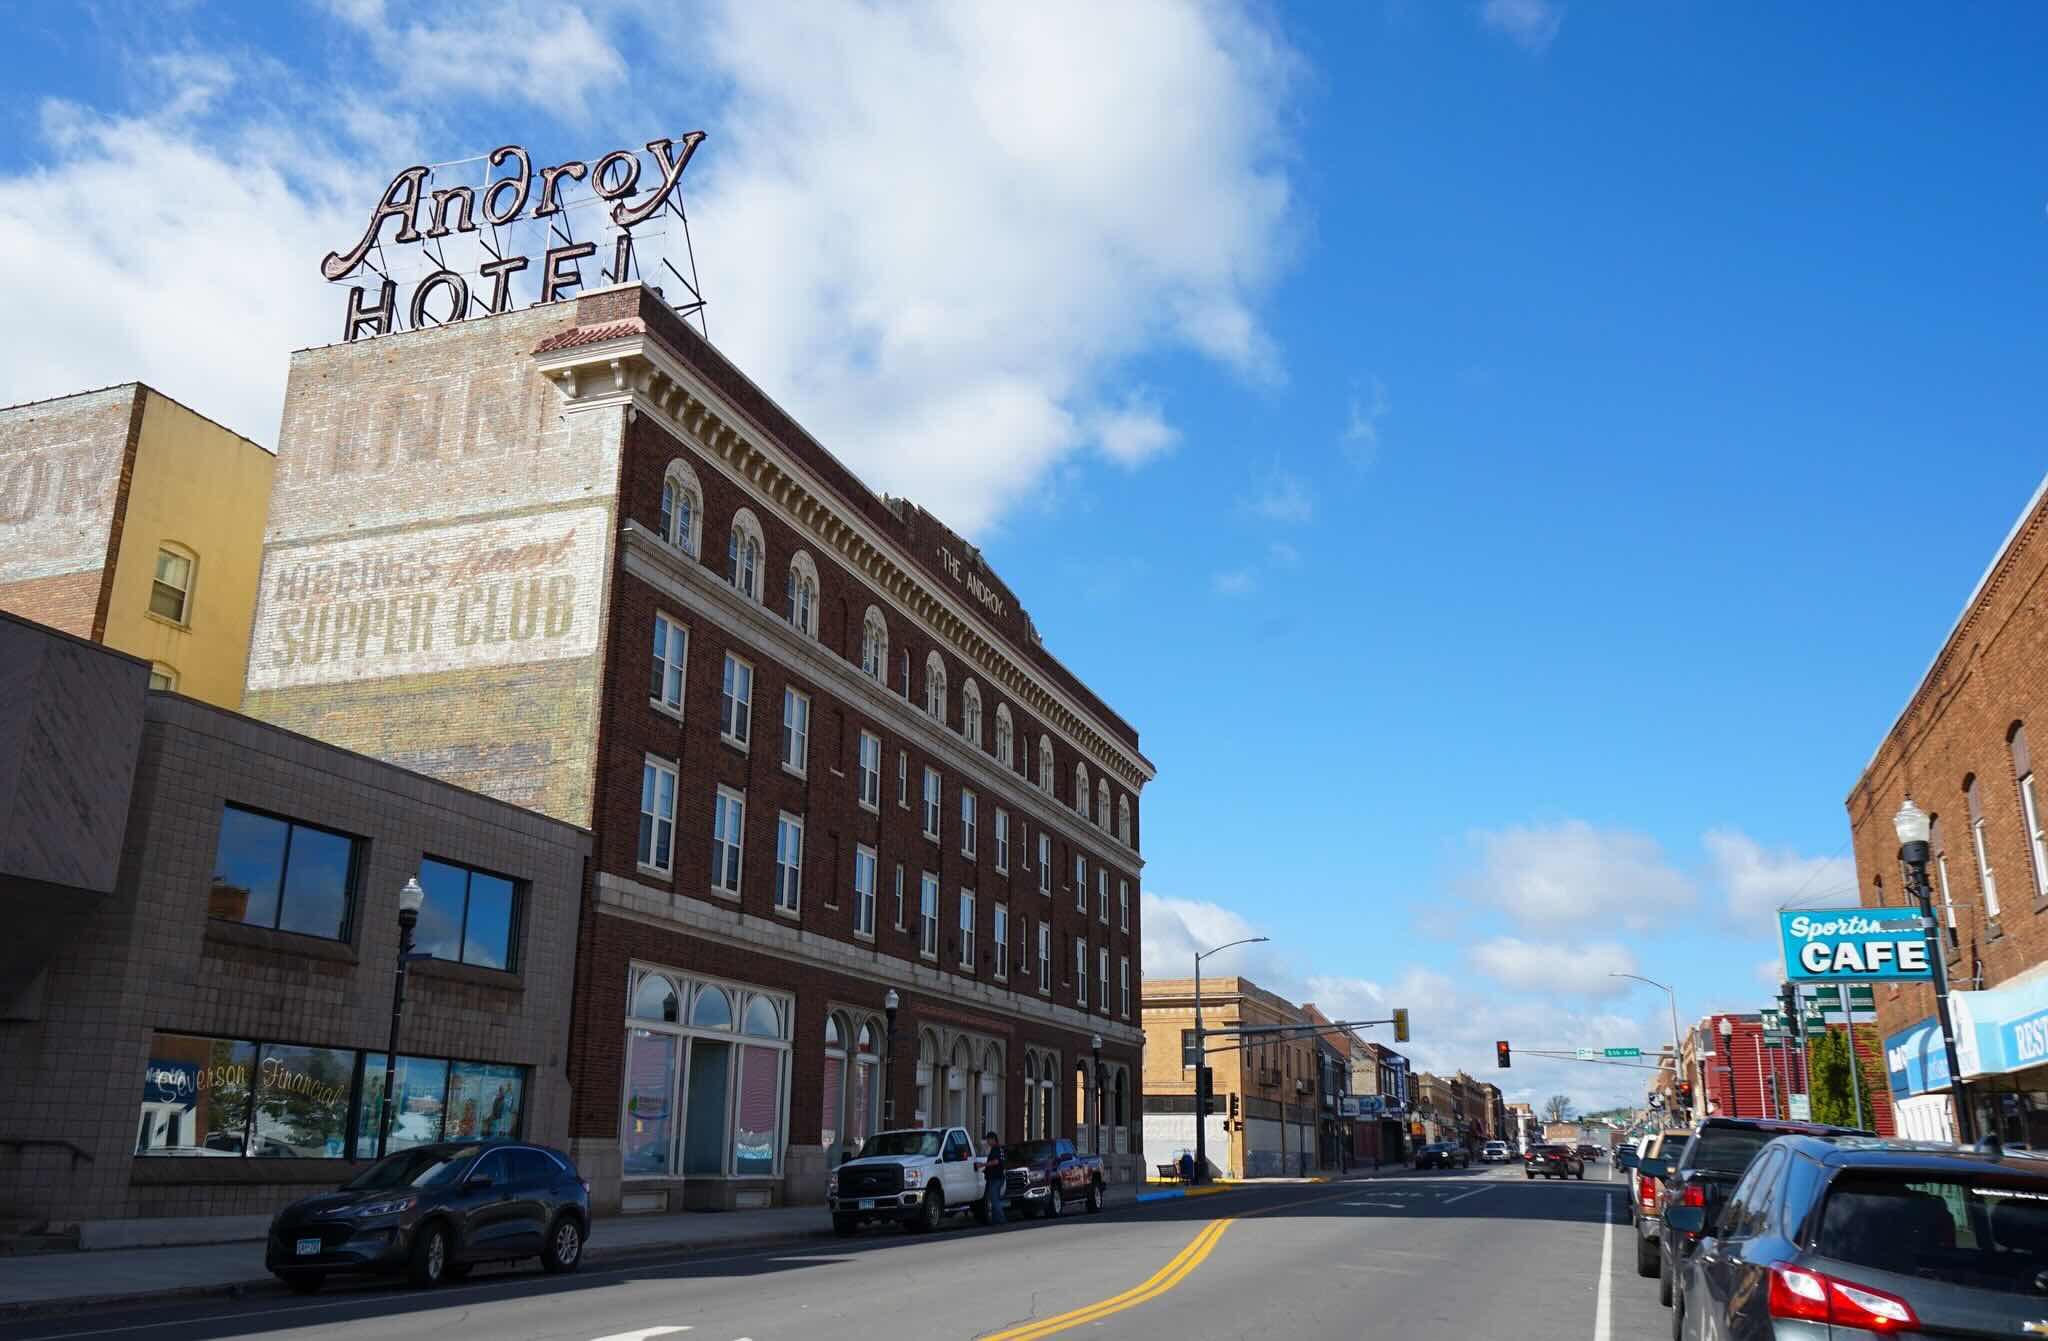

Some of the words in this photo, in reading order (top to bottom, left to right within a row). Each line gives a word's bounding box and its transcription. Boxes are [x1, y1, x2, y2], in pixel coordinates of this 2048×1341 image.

[321, 130, 706, 281] Androy
[941, 545, 962, 584] THE
[966, 571, 1004, 617] ANDROY
[272, 592, 438, 668] SUPPER
[454, 573, 578, 647] CLUB
[1800, 940, 1930, 974] CAFE
[157, 1063, 247, 1105] Severson
[262, 1056, 346, 1106] Financial
